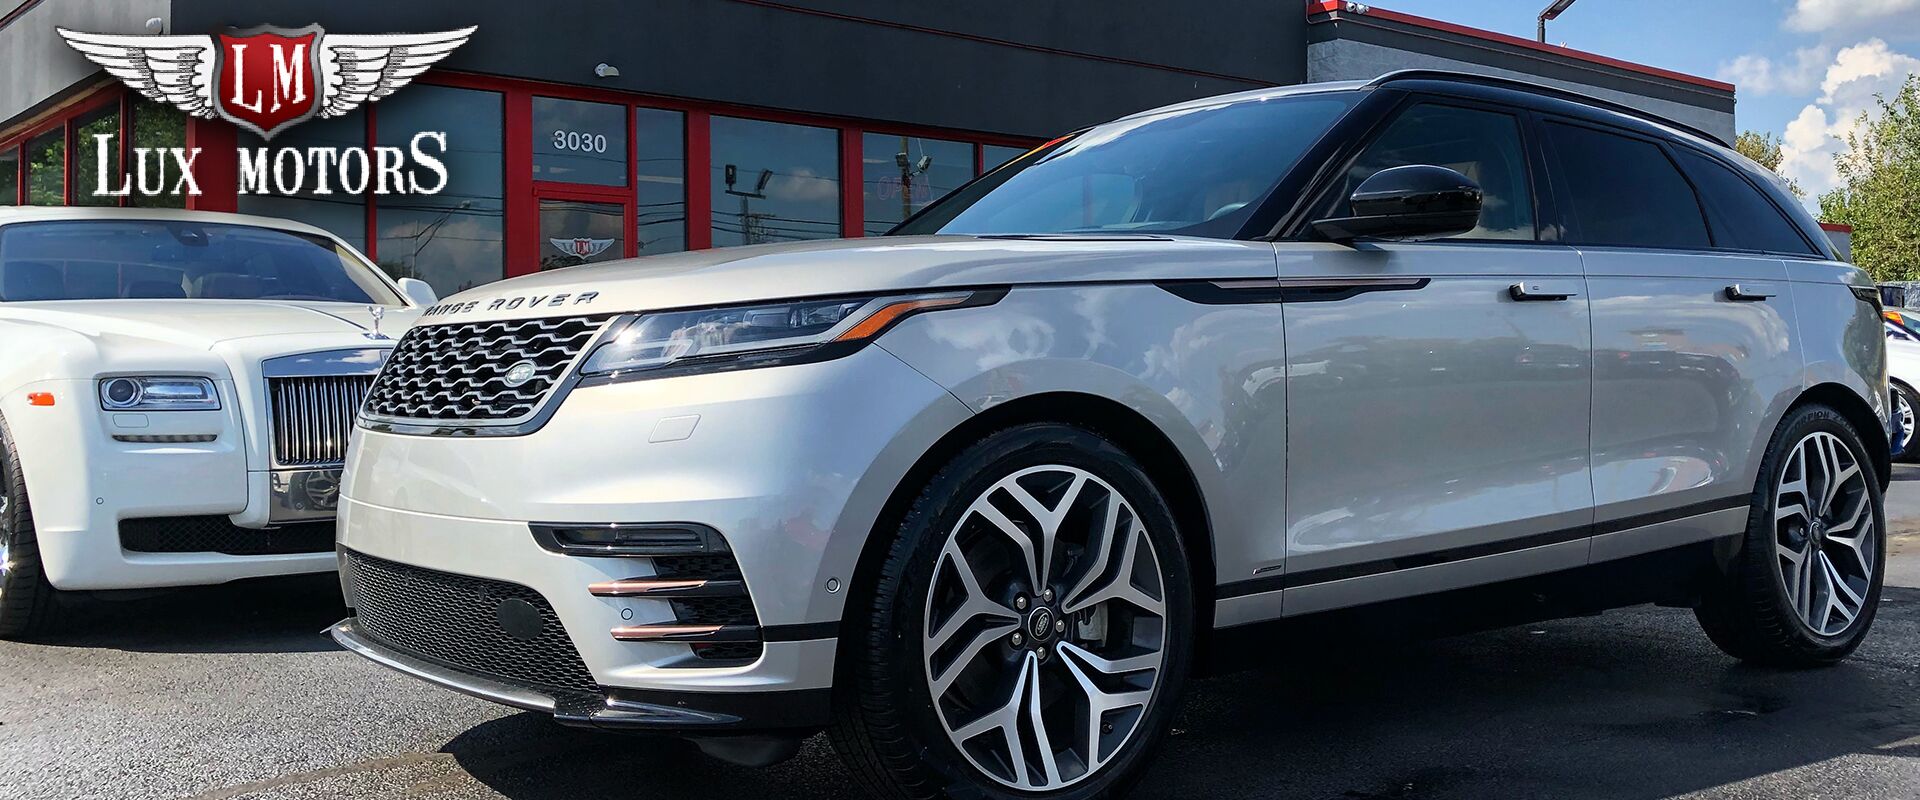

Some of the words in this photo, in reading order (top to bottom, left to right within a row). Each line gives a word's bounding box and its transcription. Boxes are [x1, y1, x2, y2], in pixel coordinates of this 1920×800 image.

[553, 130, 607, 153] 3030
[576, 240, 590, 255] LM
[421, 300, 480, 318] RANGE
[486, 291, 600, 312] ROVER
[1788, 410, 1831, 432] ORPION
